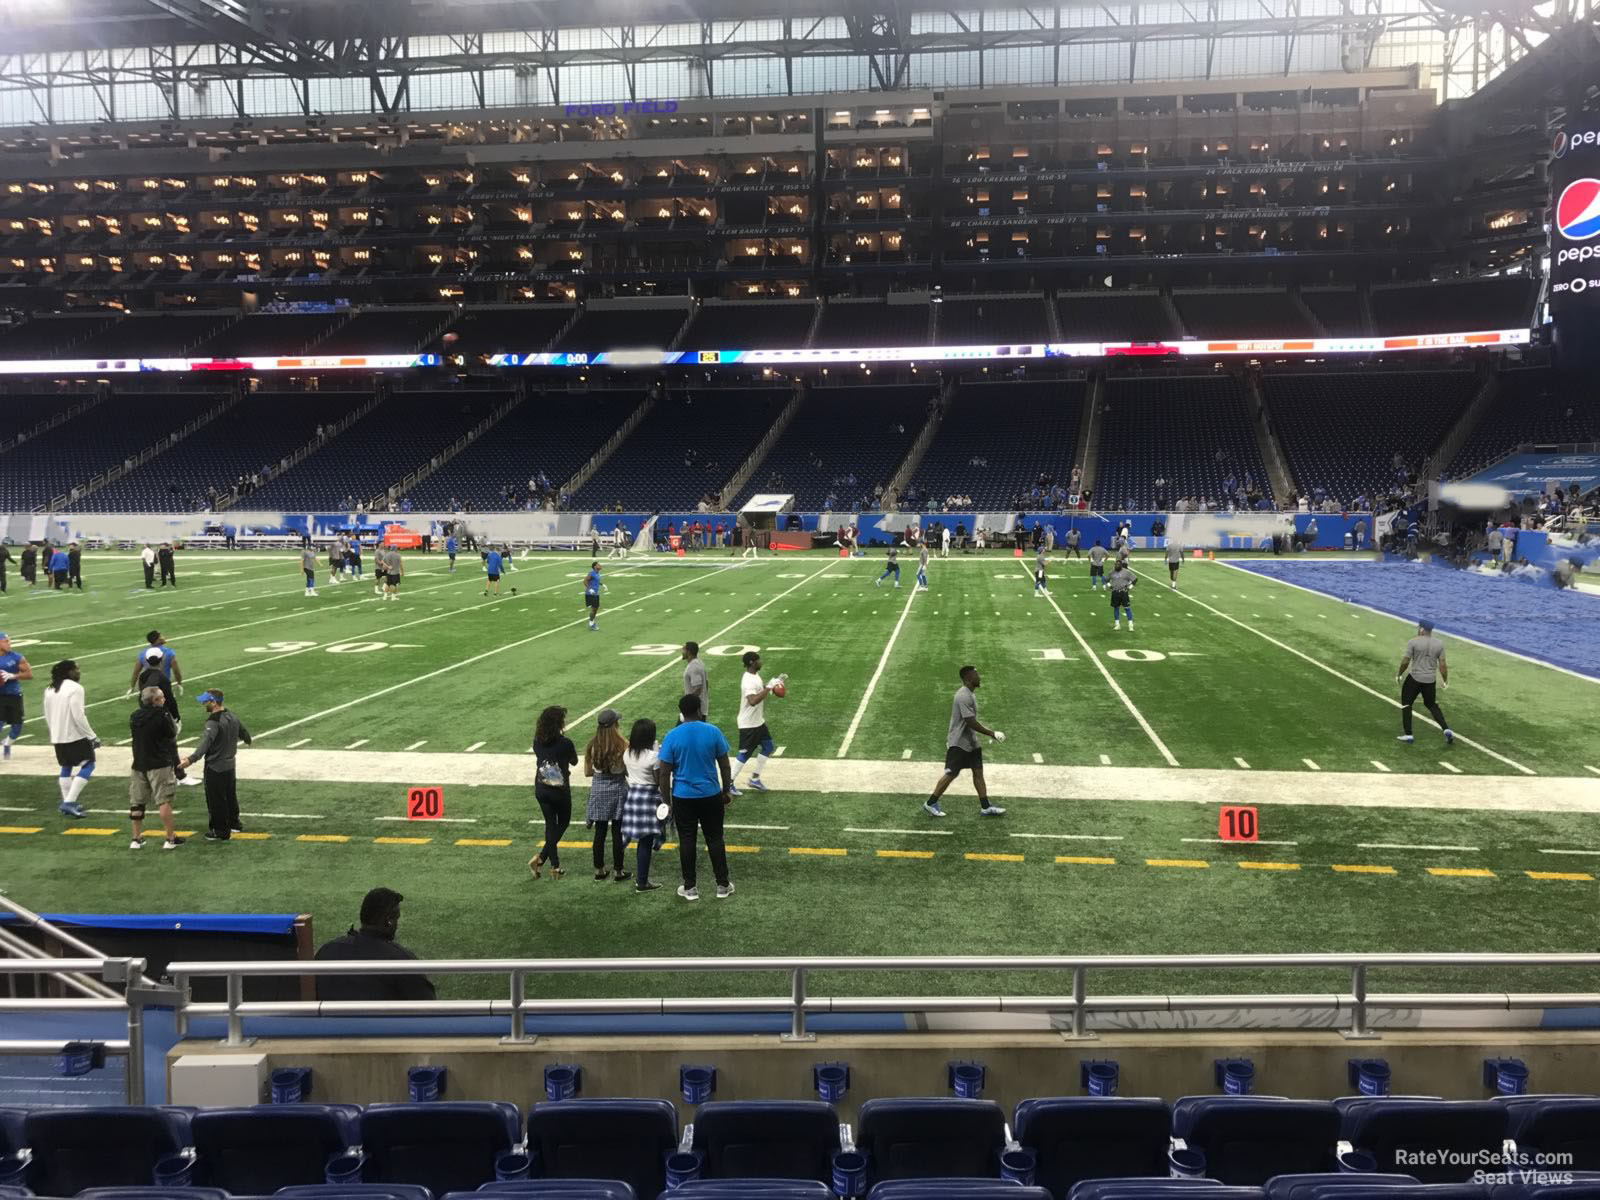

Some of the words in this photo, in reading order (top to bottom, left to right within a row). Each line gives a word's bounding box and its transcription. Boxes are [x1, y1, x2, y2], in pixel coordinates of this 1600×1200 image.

[564, 103, 617, 117] FORD
[623, 99, 678, 114] FIELD
[566, 352, 588, 364] 0:00
[410, 789, 440, 818] 20
[1224, 809, 1255, 839] 10
